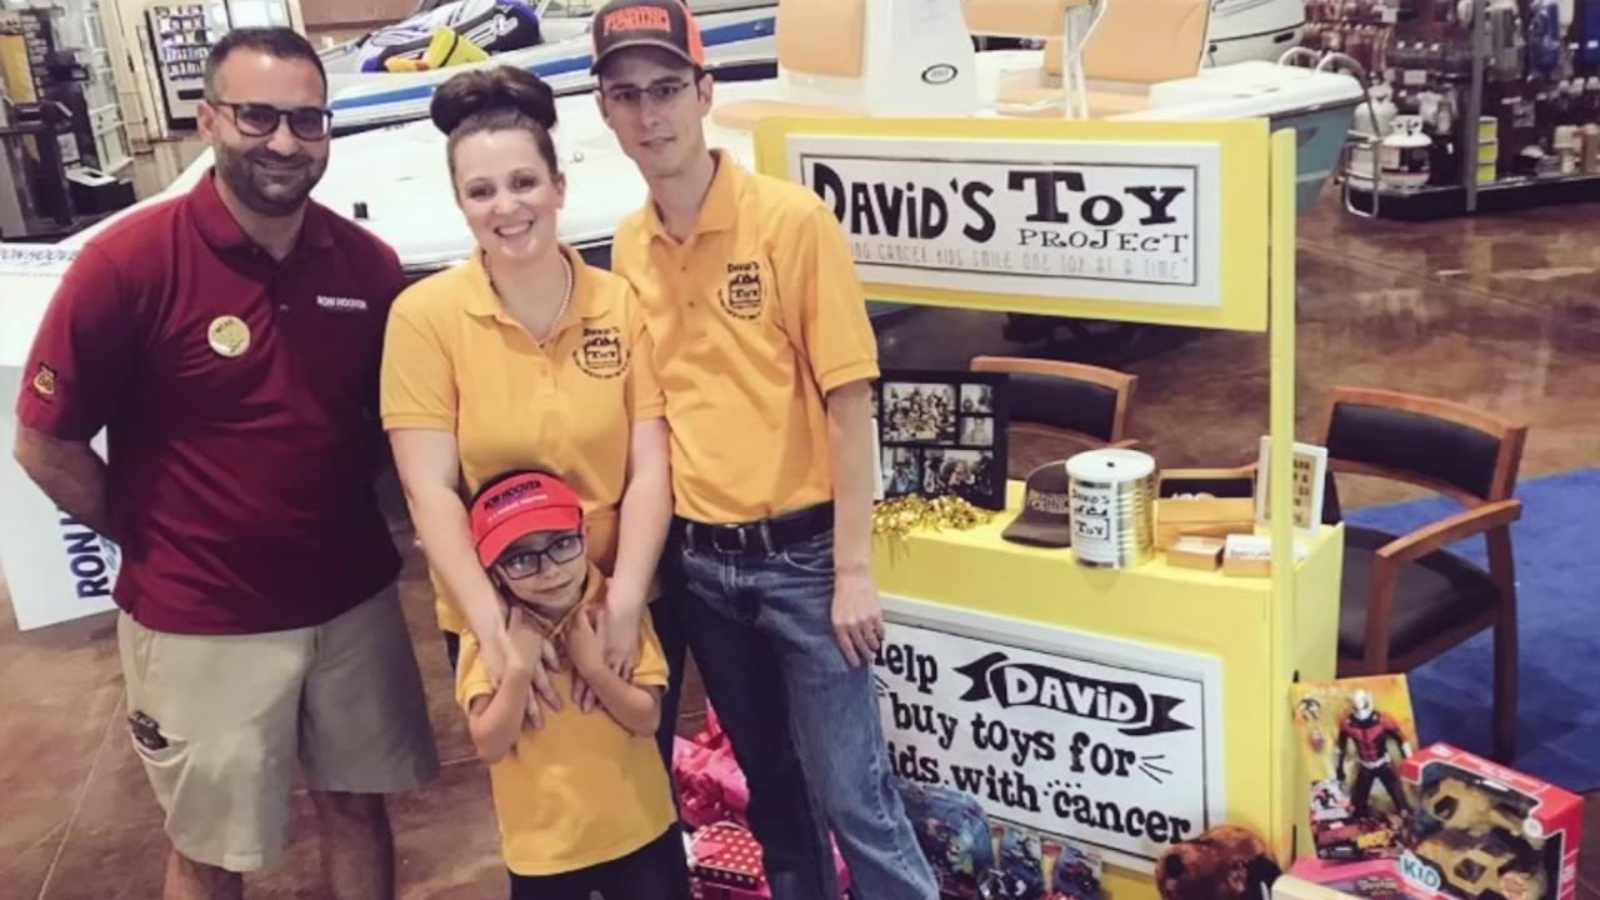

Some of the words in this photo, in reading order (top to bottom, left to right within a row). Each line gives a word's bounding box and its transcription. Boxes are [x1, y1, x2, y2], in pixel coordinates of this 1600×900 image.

[63, 532, 111, 599] RON
[889, 691, 958, 750] buy
[971, 712, 1056, 767] toys
[1069, 731, 1136, 778] for
[887, 740, 942, 784] ids
[951, 764, 1041, 813] with
[1052, 789, 1191, 845] cancer
